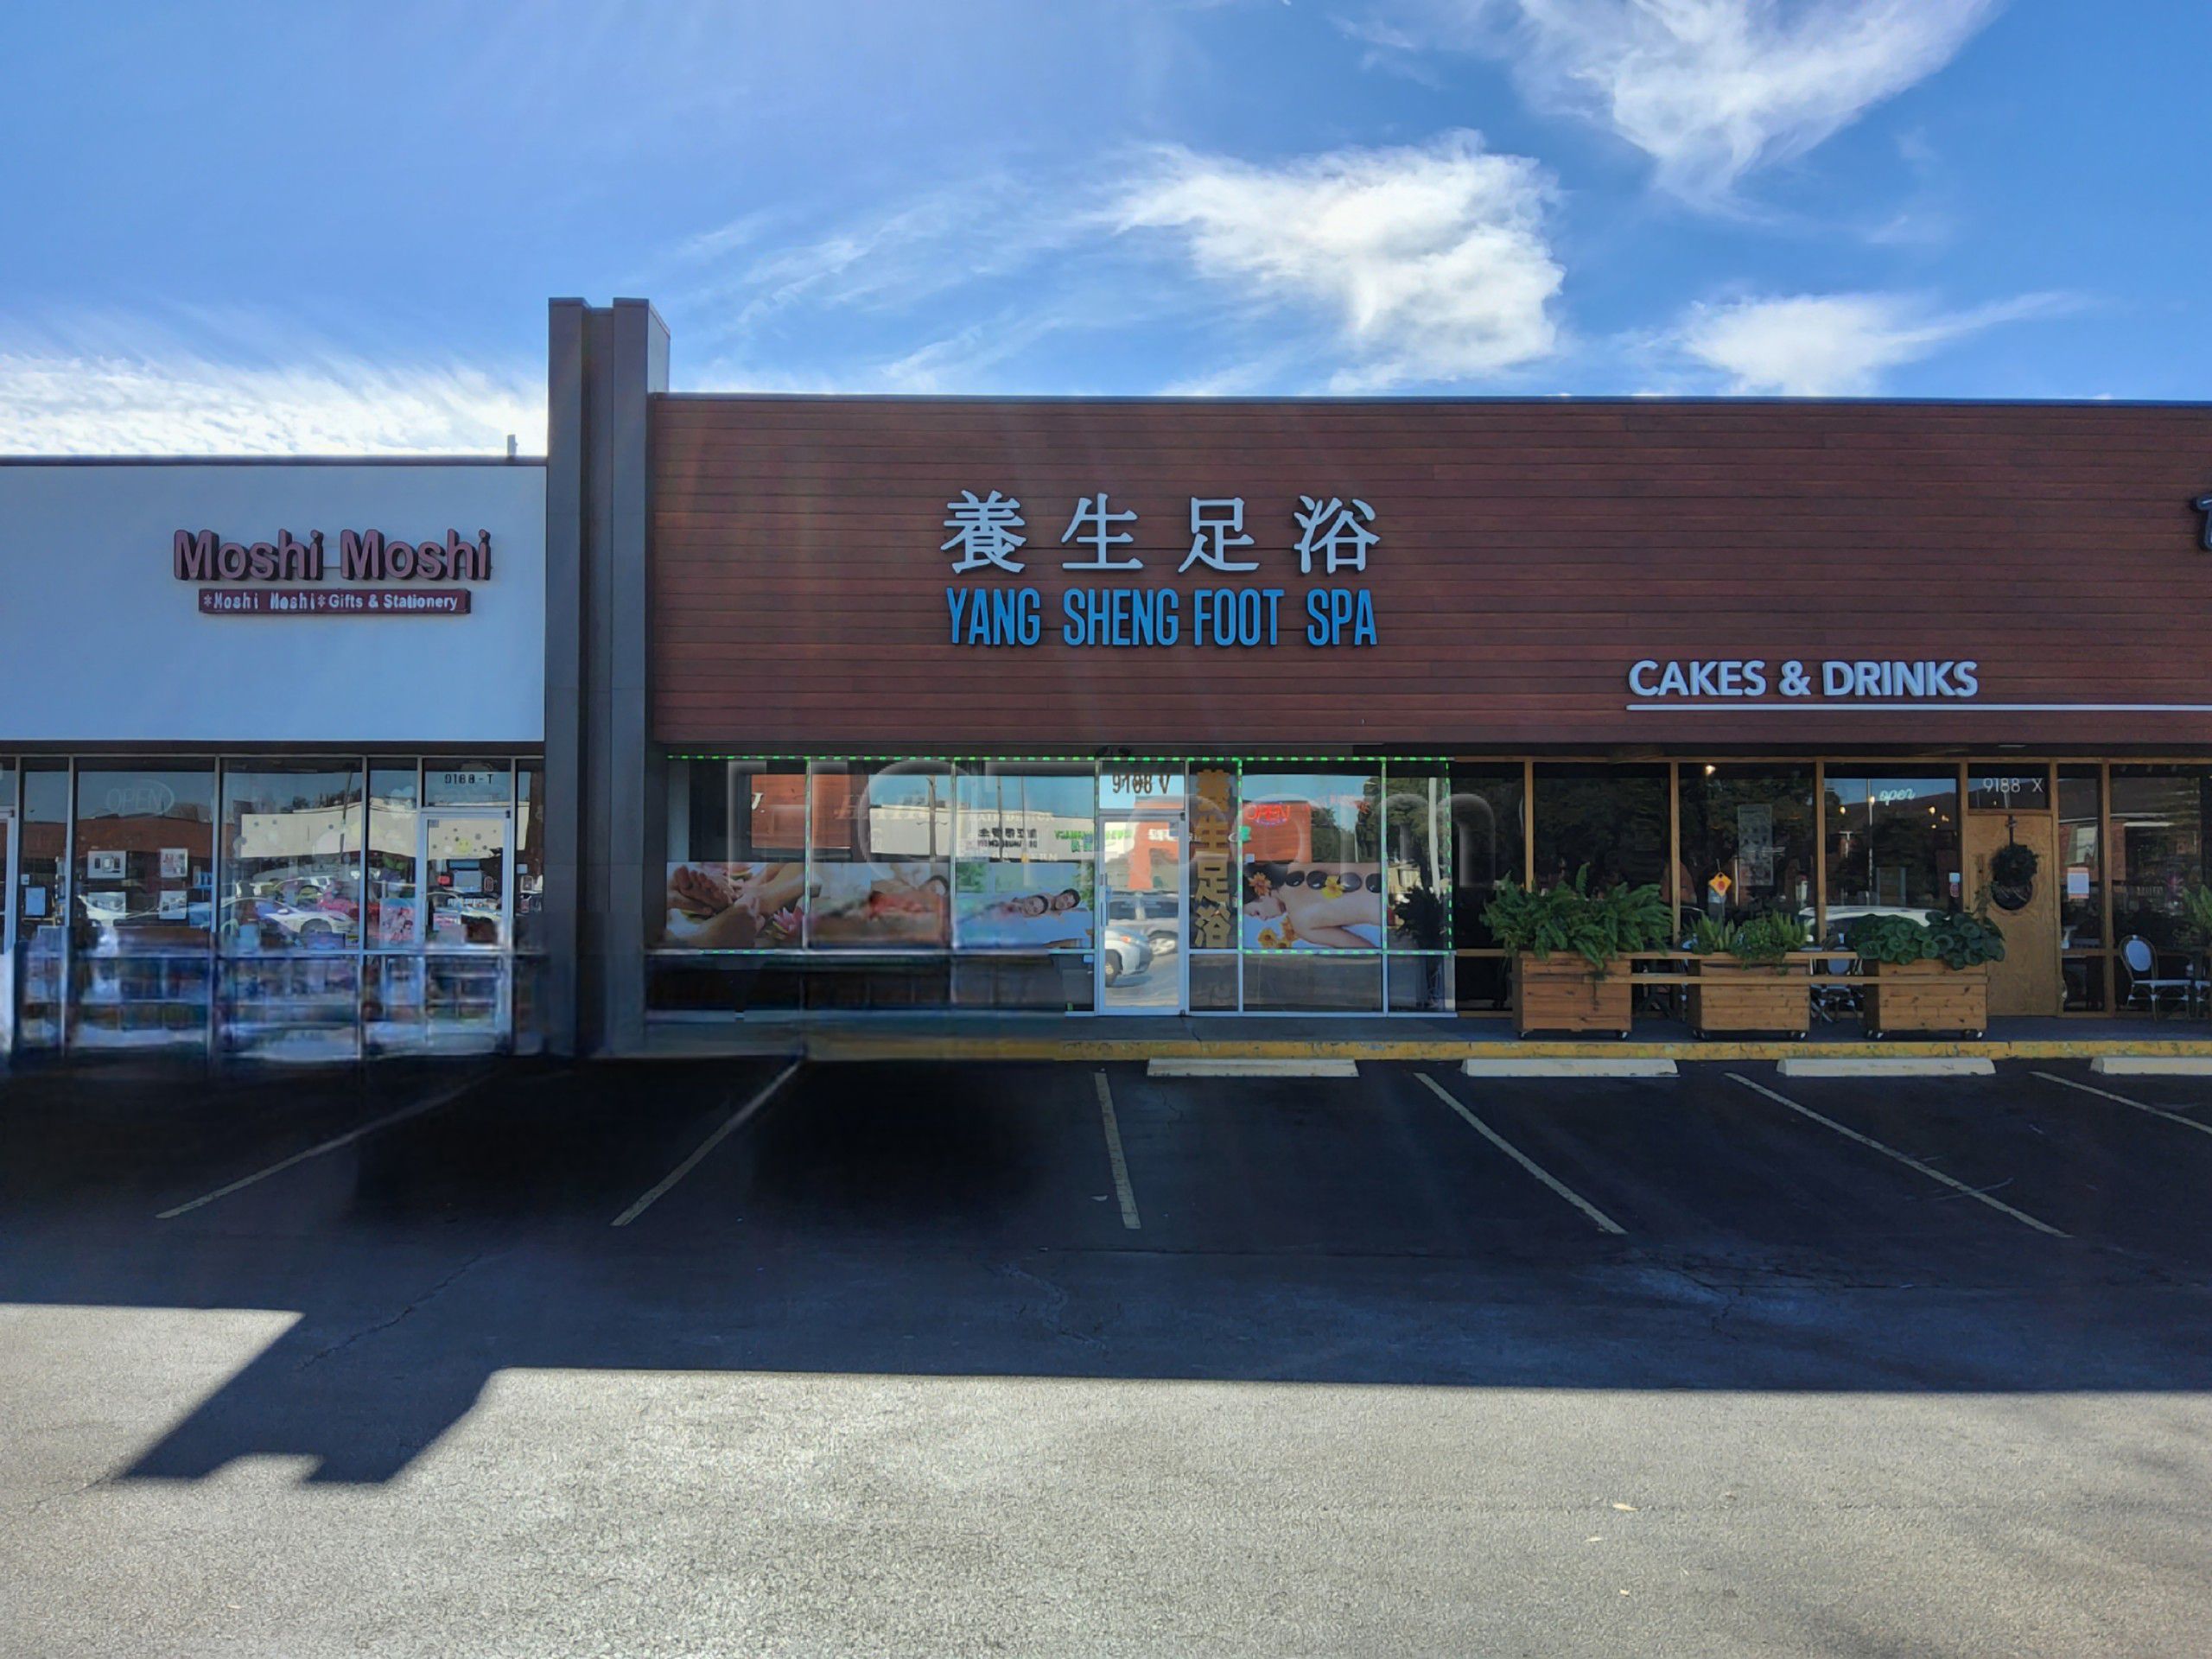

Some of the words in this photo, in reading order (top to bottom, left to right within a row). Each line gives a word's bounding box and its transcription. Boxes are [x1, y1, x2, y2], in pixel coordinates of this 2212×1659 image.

[940, 489, 1381, 574] 養生足浴
[174, 528, 324, 581] Moshi
[340, 528, 493, 581] Moshi
[328, 593, 363, 609] Gifts
[368, 594, 379, 609] &
[384, 594, 458, 611] Stationery
[946, 588, 1042, 647] YANG
[1062, 588, 1180, 647] SHENG
[1193, 588, 1285, 647] FOOT
[1306, 588, 1379, 647] SPA
[1628, 659, 1766, 698] CAKES
[1778, 659, 1811, 698] &
[1822, 659, 1980, 698] DRINKS
[1159, 772, 1171, 794] V
[1982, 778, 2021, 793] 9188
[2031, 778, 2044, 793] X
[1244, 803, 1291, 822] OPEN
